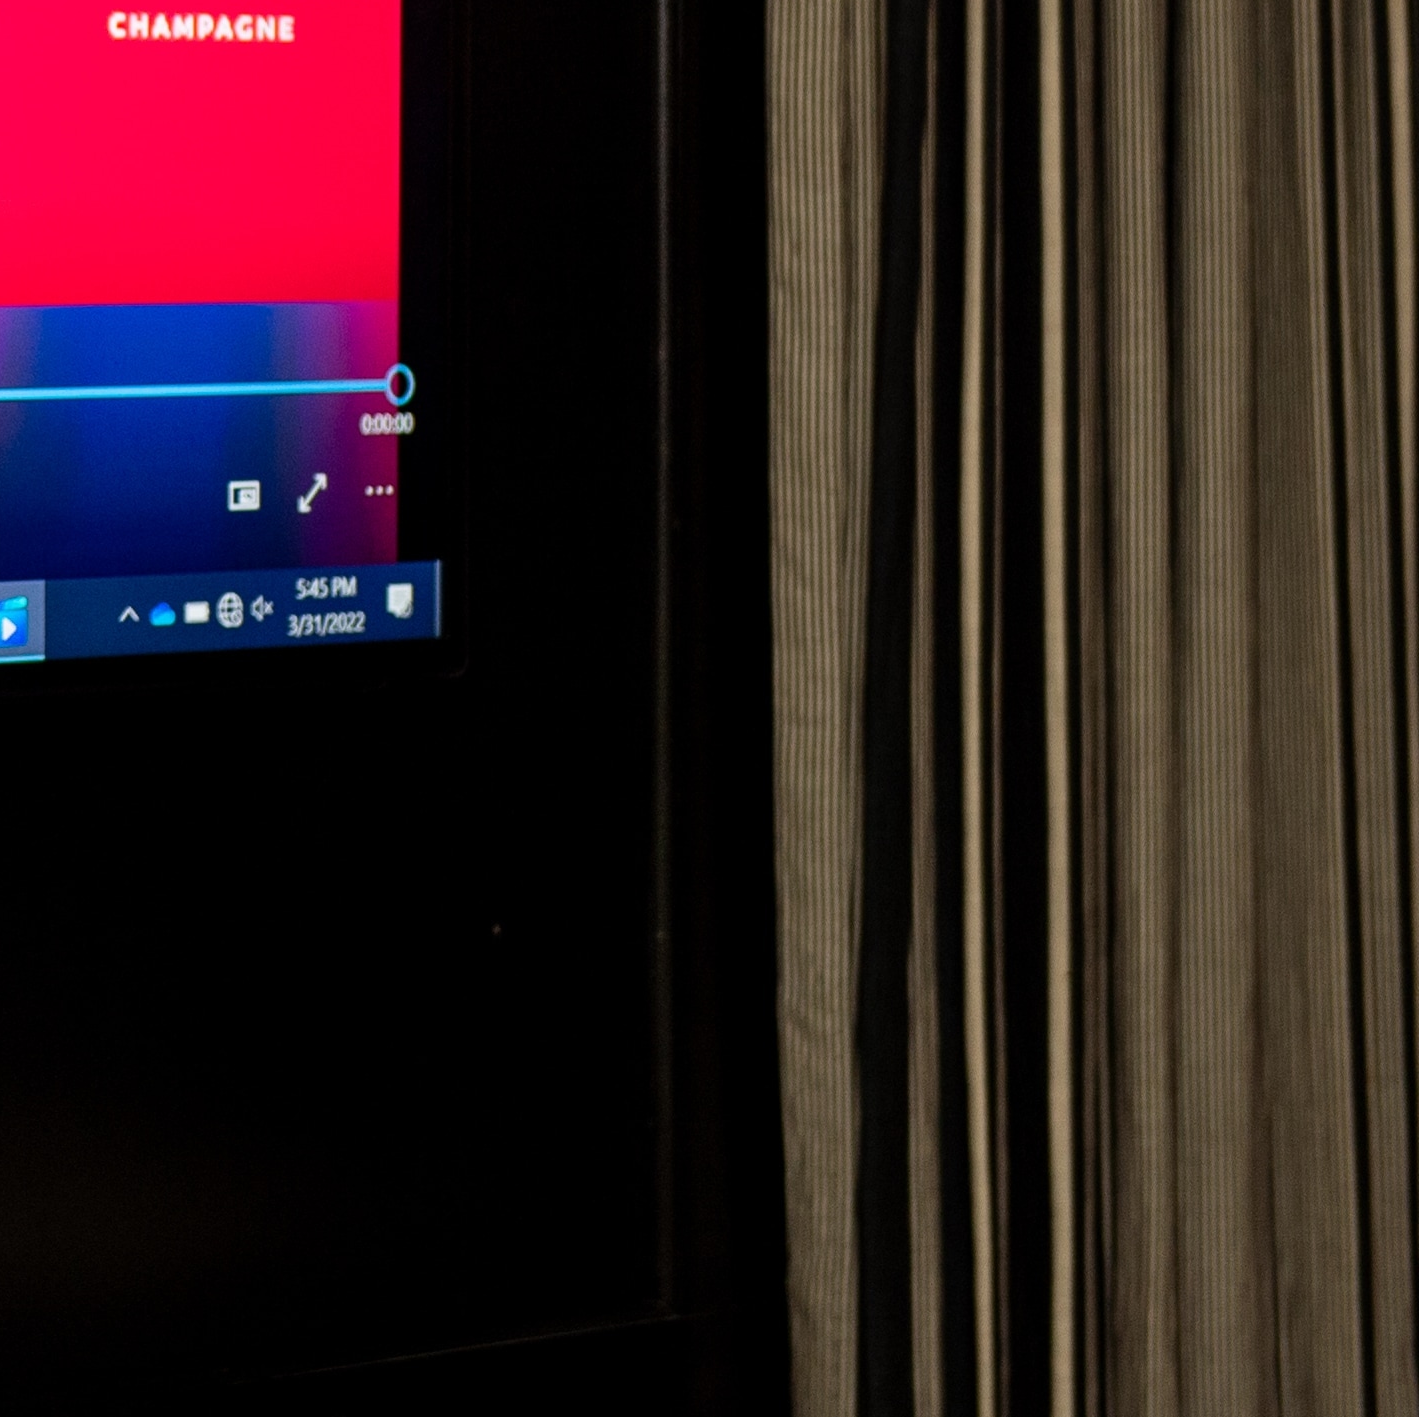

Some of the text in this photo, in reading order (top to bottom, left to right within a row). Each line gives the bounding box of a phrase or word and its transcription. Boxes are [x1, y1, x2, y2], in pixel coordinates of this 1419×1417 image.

[108, 12, 295, 42] CHAMPAGNE
[359, 412, 415, 435] 0:00:00
[295, 575, 357, 601] 5:45 PM
[287, 610, 365, 638] 3/31/2022
